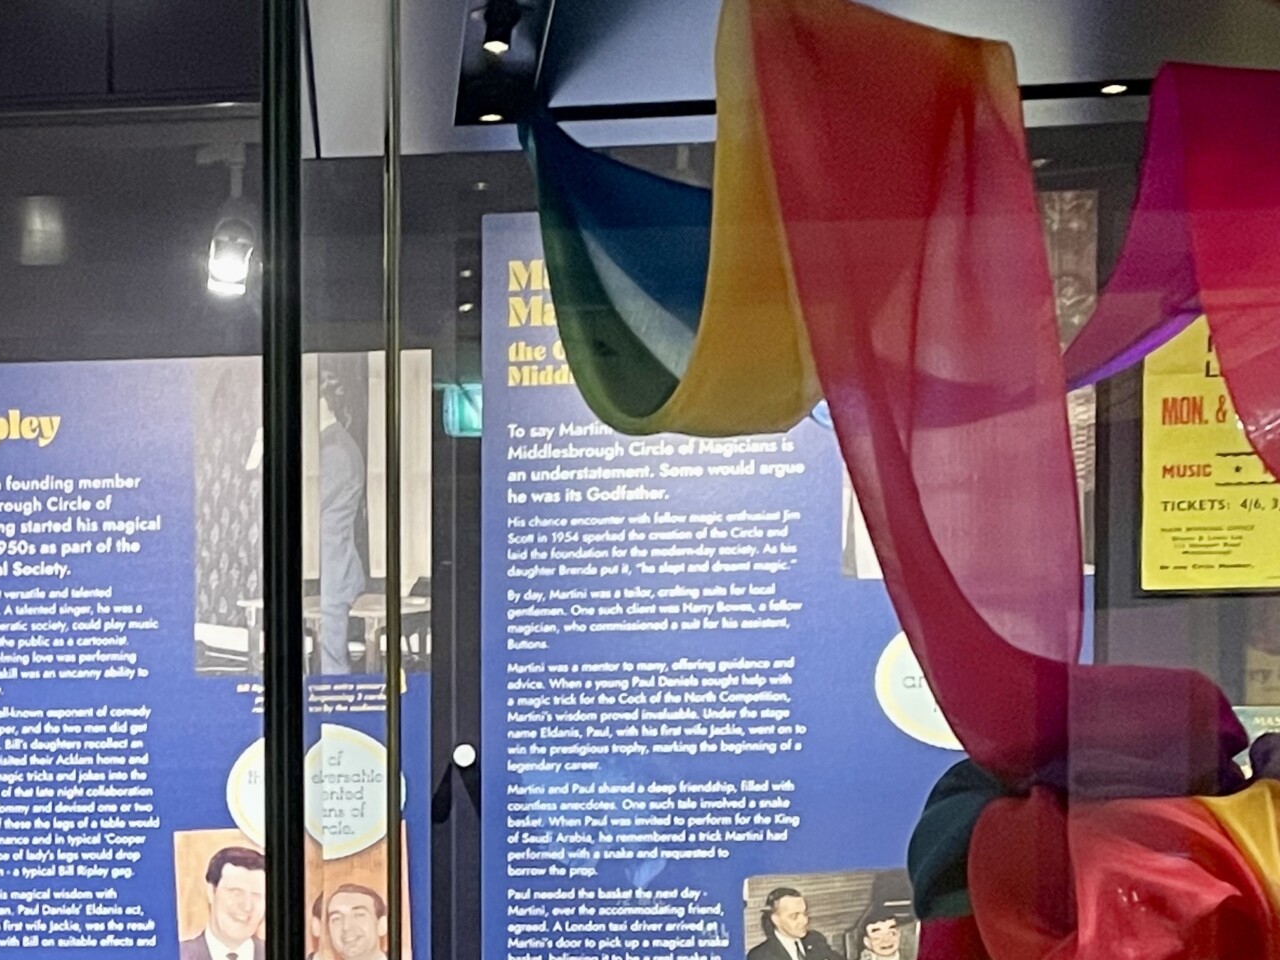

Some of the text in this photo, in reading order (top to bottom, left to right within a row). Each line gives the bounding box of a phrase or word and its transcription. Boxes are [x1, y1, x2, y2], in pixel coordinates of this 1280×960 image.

[507, 341, 548, 362] the
[1161, 394, 1228, 426] MON. &
[507, 423, 526, 438] To
[529, 426, 556, 441] say
[507, 437, 795, 461] Middlesbrough Circle of Magicians is
[507, 458, 806, 482] an understatement. Some would argue
[1161, 463, 1212, 479] MUSIC
[5, 474, 74, 494] founding
[77, 473, 142, 490] member
[507, 483, 671, 504] he was its Godfather.
[46, 494, 92, 512] Circle
[95, 493, 113, 511] of
[20, 514, 73, 534] started
[76, 515, 99, 533] his
[102, 513, 162, 536] magical
[39, 542, 58, 555] as
[60, 539, 93, 558] part
[95, 536, 113, 554] of
[115, 536, 141, 553] the
[12, 560, 72, 580] Society.
